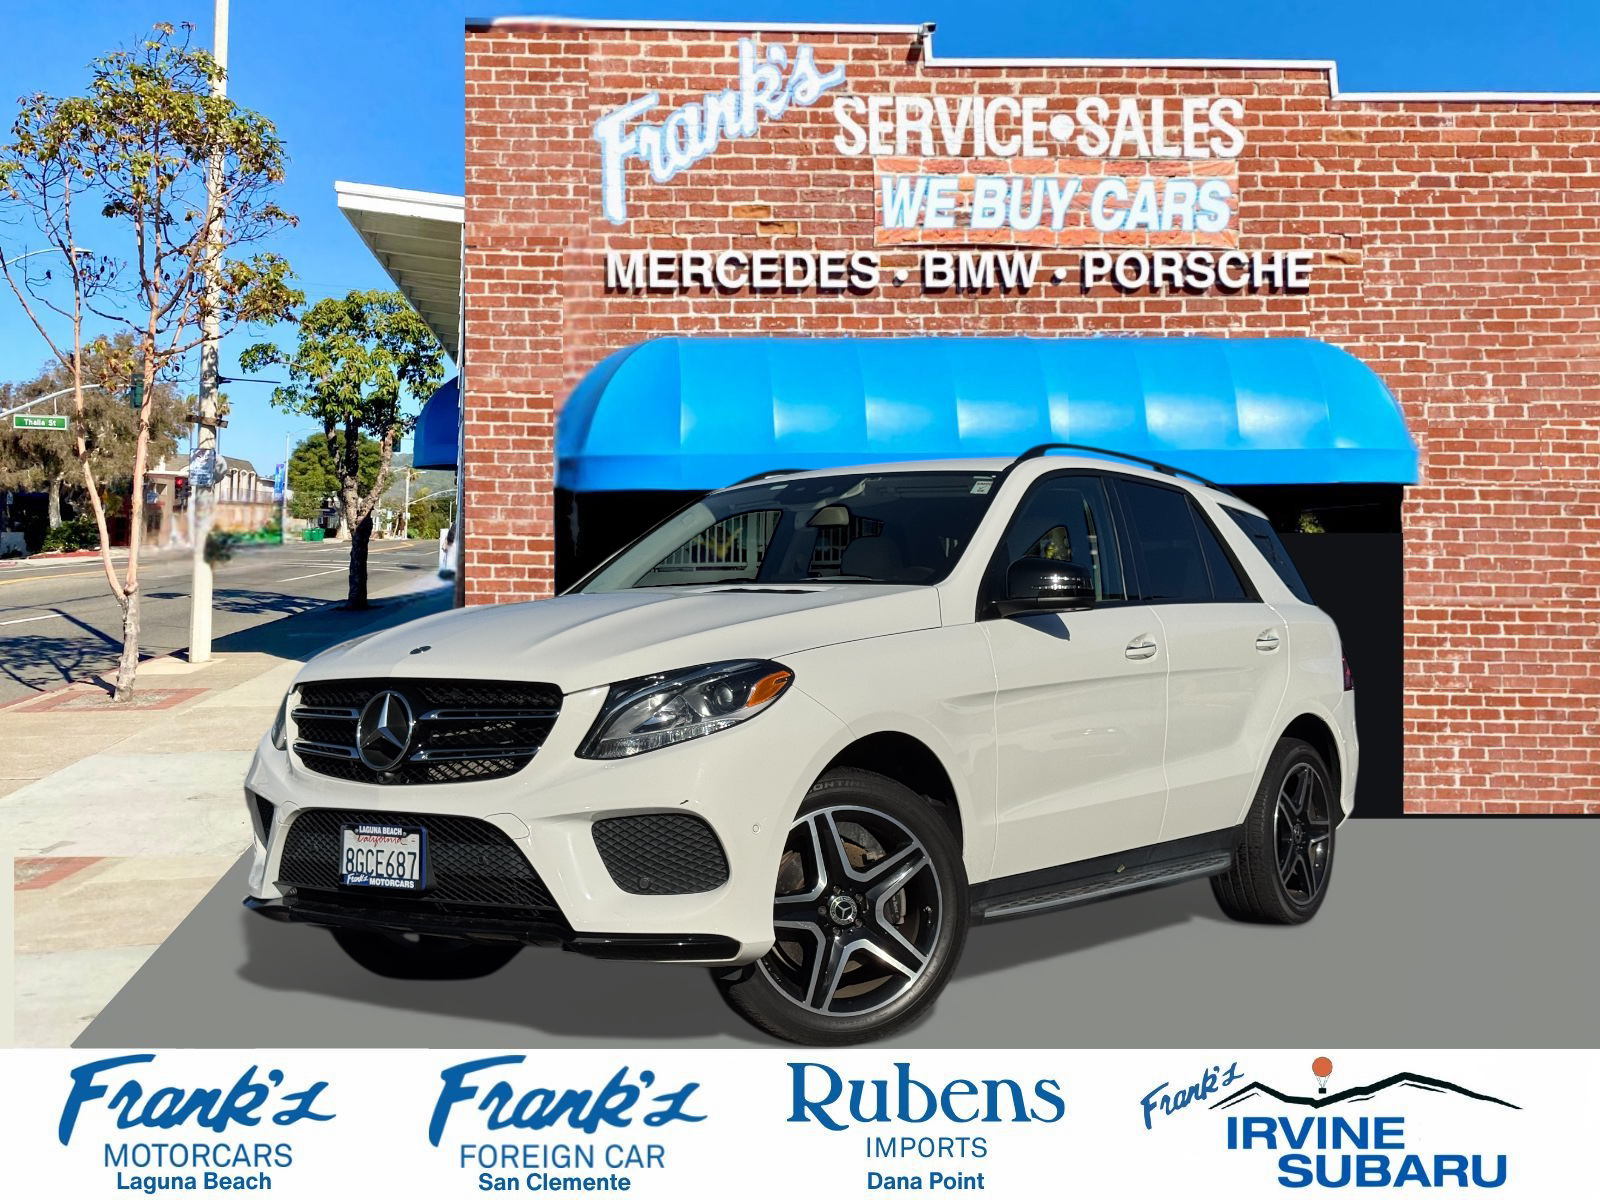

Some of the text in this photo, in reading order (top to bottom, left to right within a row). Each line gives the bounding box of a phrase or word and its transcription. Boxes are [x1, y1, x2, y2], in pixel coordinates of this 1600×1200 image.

[593, 37, 846, 226] Frank's
[833, 96, 1245, 158] SERVICE SALES
[880, 174, 1233, 234] WE BUY CARS
[605, 249, 1314, 292] MERCEDES BMW PORSCHE
[23, 417, 57, 427] Thalia St
[358, 825, 403, 836] LAGUNA BEACH
[345, 847, 417, 880] 8GCE687
[369, 877, 415, 889] MOTORCARS
